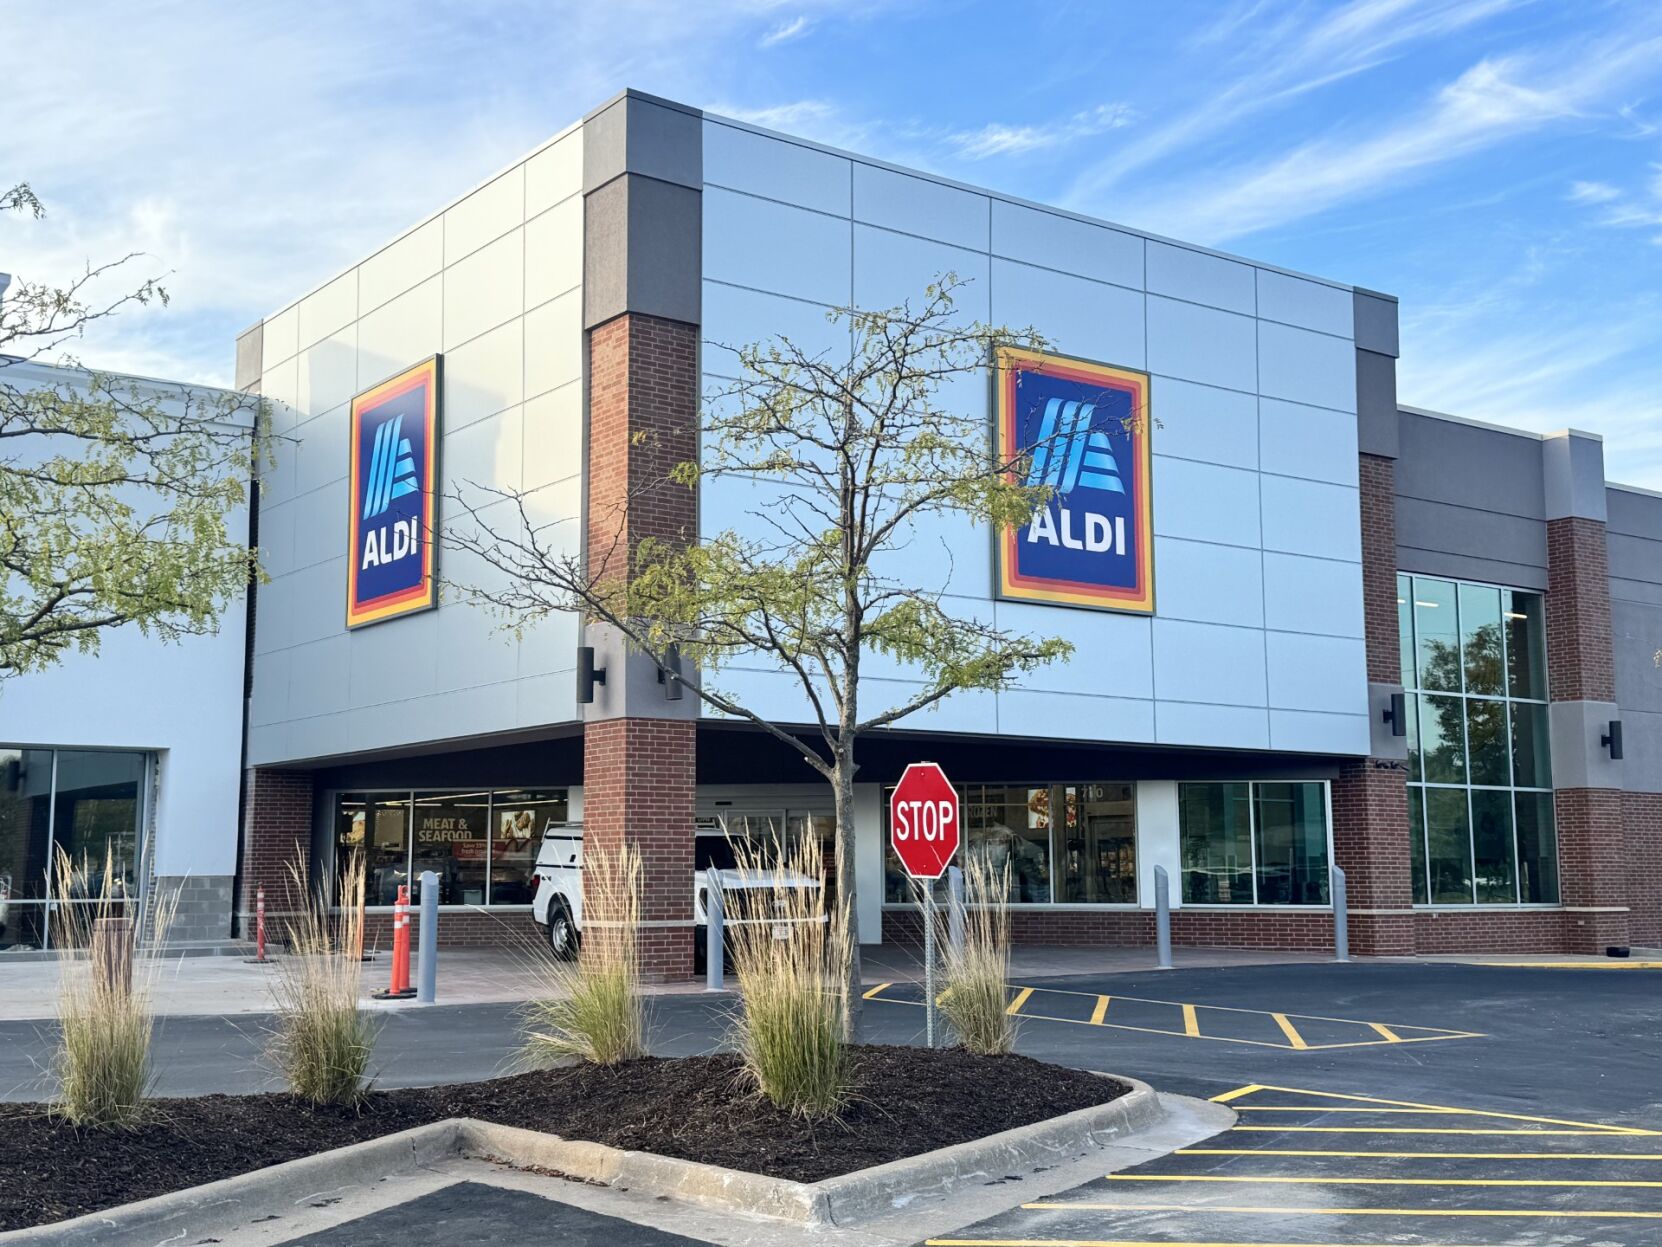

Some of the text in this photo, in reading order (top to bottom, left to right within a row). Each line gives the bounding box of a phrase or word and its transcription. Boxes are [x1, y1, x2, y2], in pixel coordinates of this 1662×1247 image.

[361, 515, 418, 571] ALDI
[1027, 504, 1126, 556] ALDI
[423, 817, 468, 830] MEAT &
[896, 800, 954, 841] STOP
[967, 804, 998, 818] ROZEN
[418, 830, 473, 842] SEAFOOD
